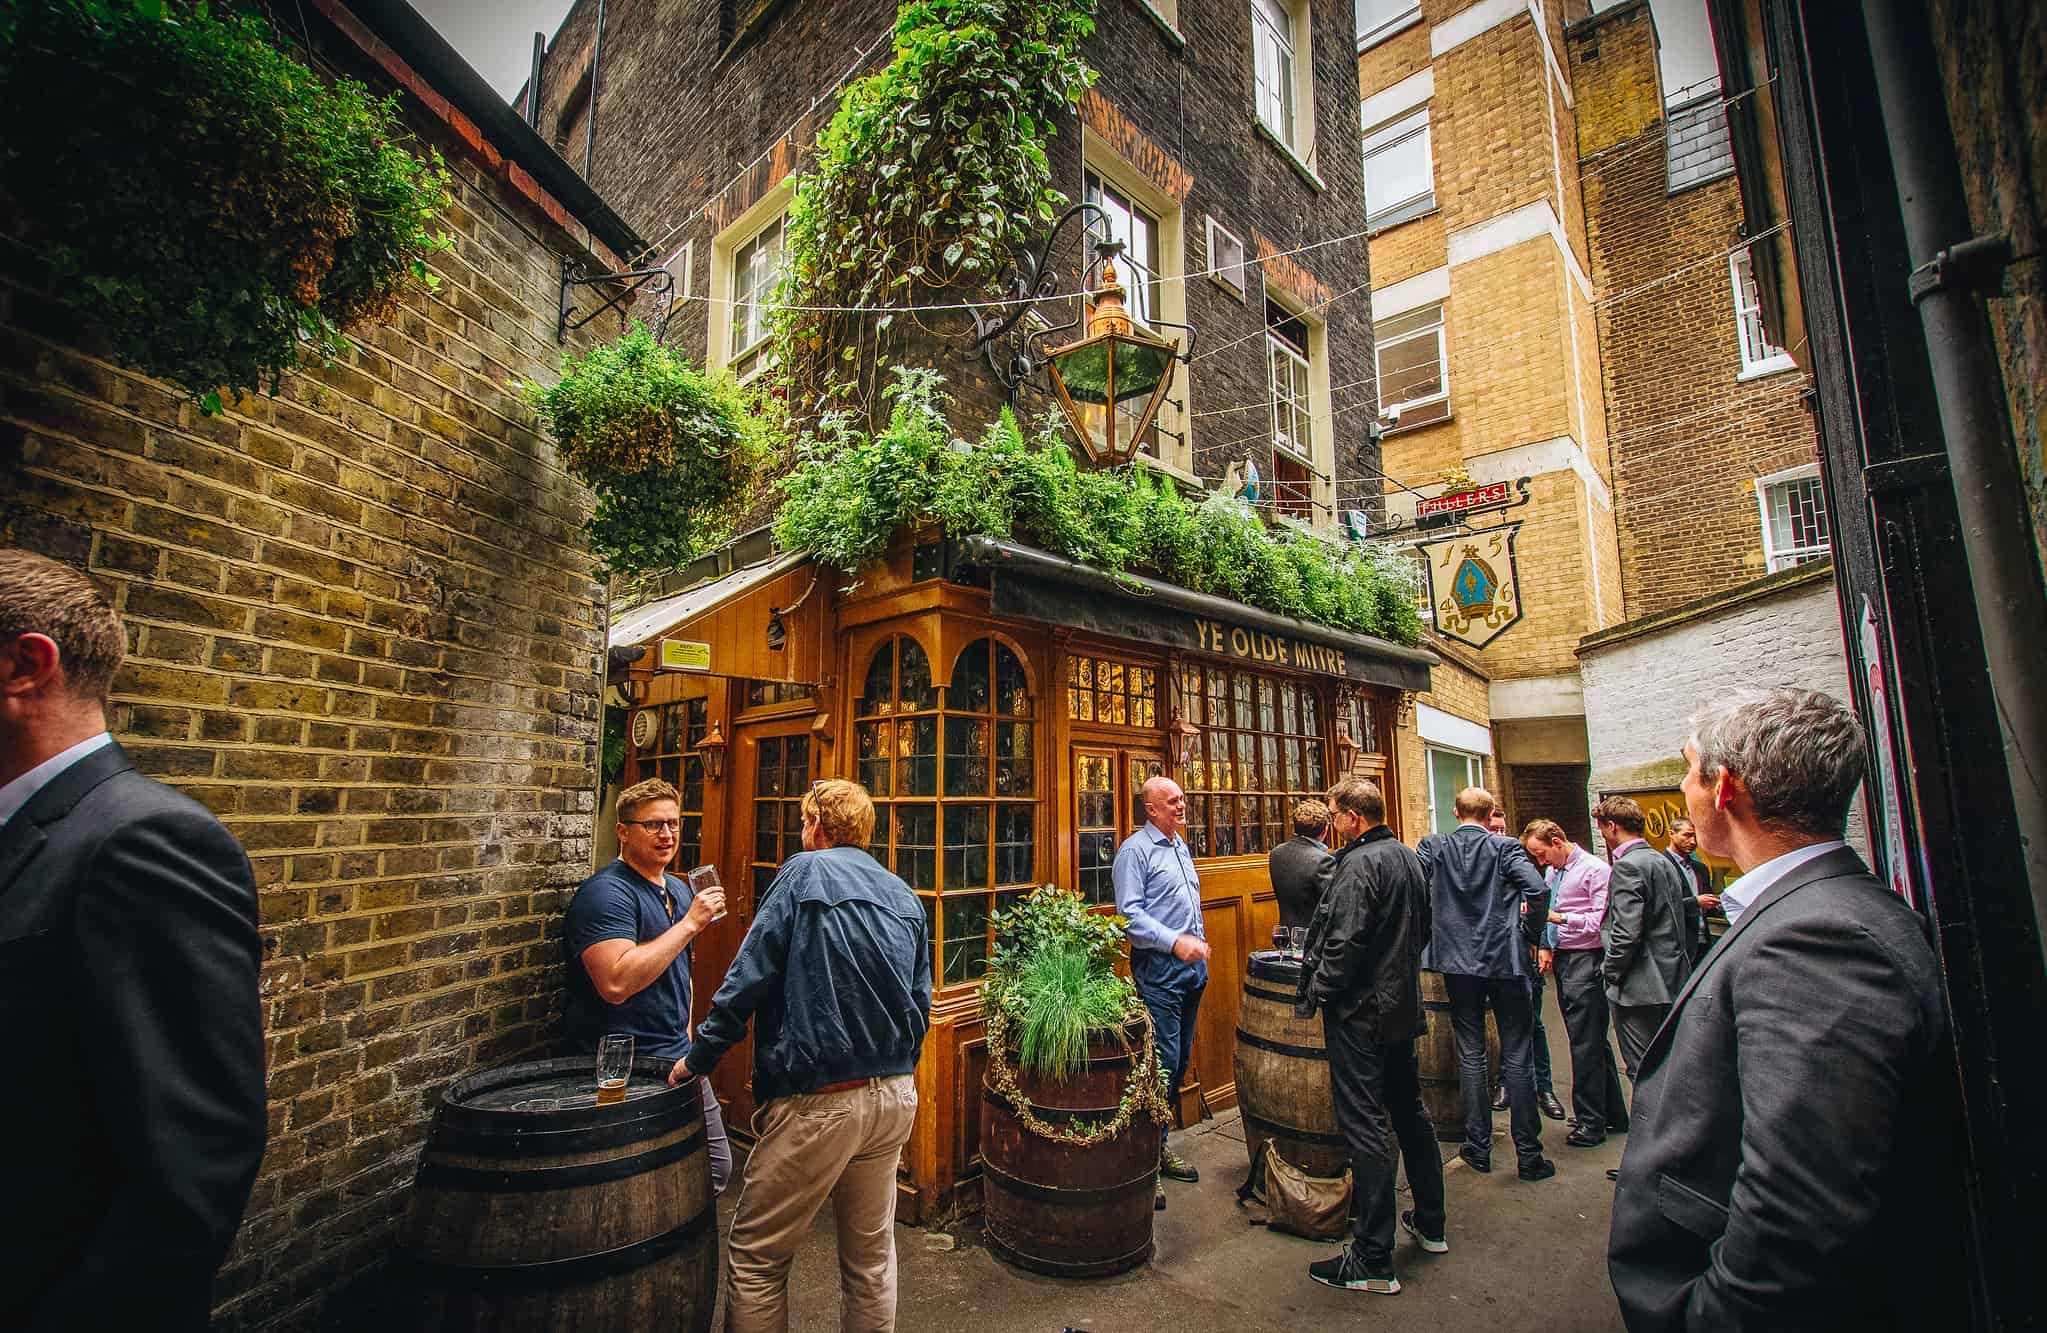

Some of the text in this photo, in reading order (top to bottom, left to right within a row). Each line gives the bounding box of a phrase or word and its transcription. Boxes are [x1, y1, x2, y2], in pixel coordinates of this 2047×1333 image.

[1488, 532, 1502, 558] 5
[1440, 582, 1513, 613] 4 6
[1194, 618, 1347, 676] YE OLDE MITRE
